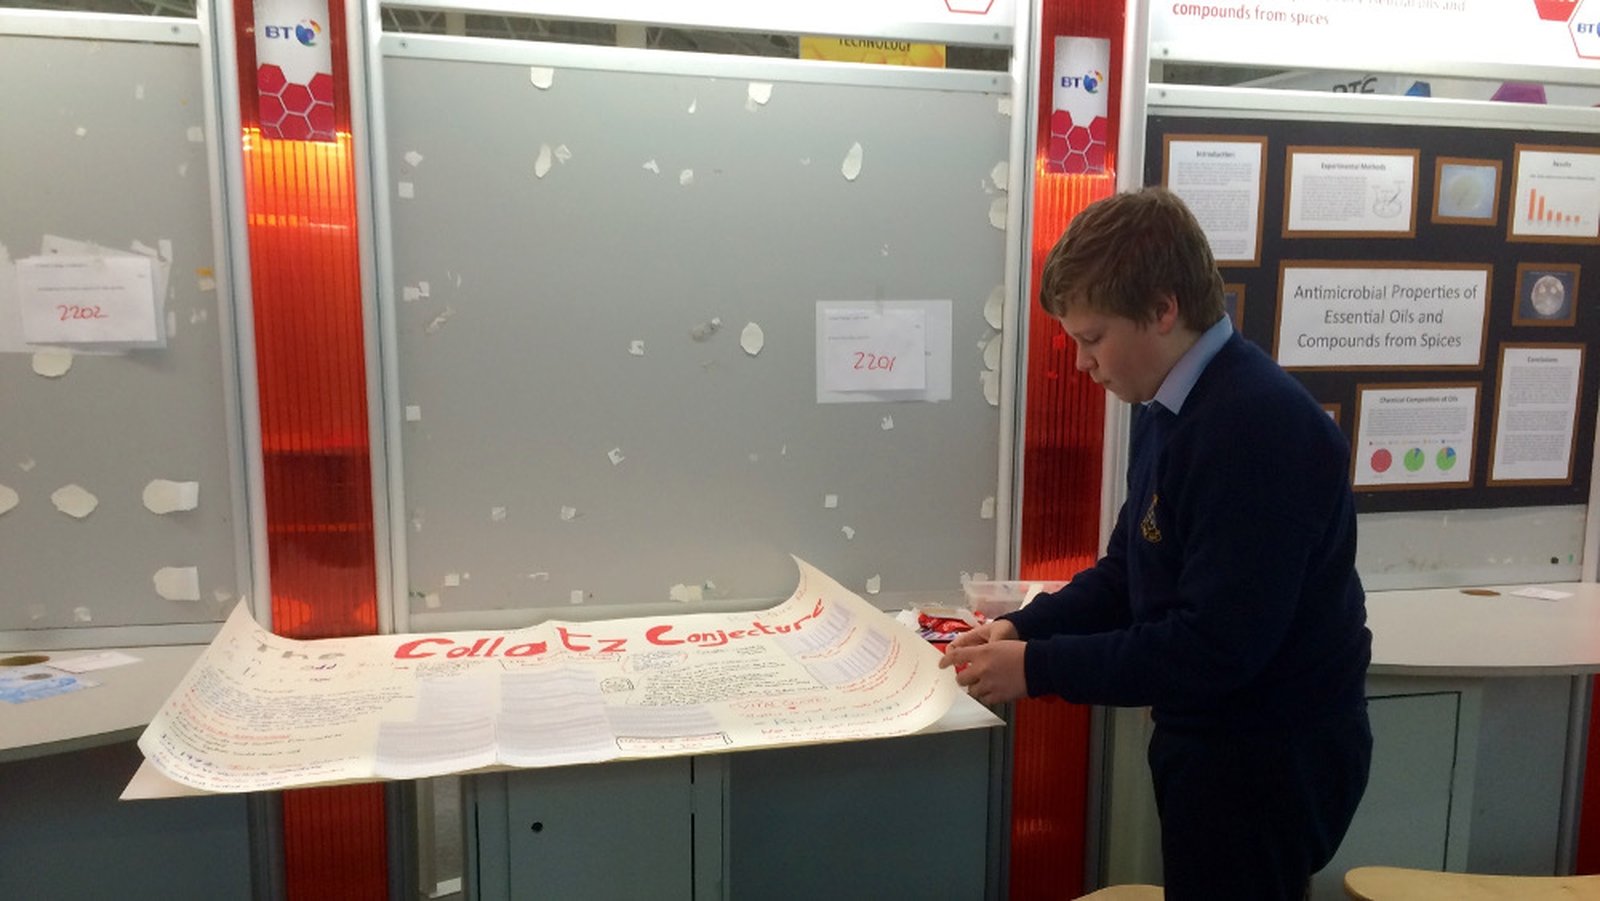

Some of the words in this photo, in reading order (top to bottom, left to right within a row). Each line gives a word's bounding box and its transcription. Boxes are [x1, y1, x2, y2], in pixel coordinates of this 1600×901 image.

[1172, 3, 1250, 19] compounds
[1254, 5, 1287, 21] from
[1290, 12, 1329, 25] spices
[265, 25, 293, 39] BT
[1577, 23, 1595, 33] BT
[1061, 76, 1082, 88] BT
[1294, 285, 1387, 300] Antimicrobial
[1391, 285, 1460, 301] Properties
[1463, 285, 1478, 299] of
[57, 304, 109, 321] 2202
[1324, 310, 1385, 324] Essential
[1389, 309, 1415, 324] Oils
[1418, 309, 1444, 324] and
[1297, 333, 1380, 350] Compounds
[1385, 332, 1417, 347] from
[1421, 333, 1462, 349] Spices
[854, 351, 897, 371] 2201
[394, 627, 628, 659] Collatz
[645, 598, 825, 647] Conjecture
